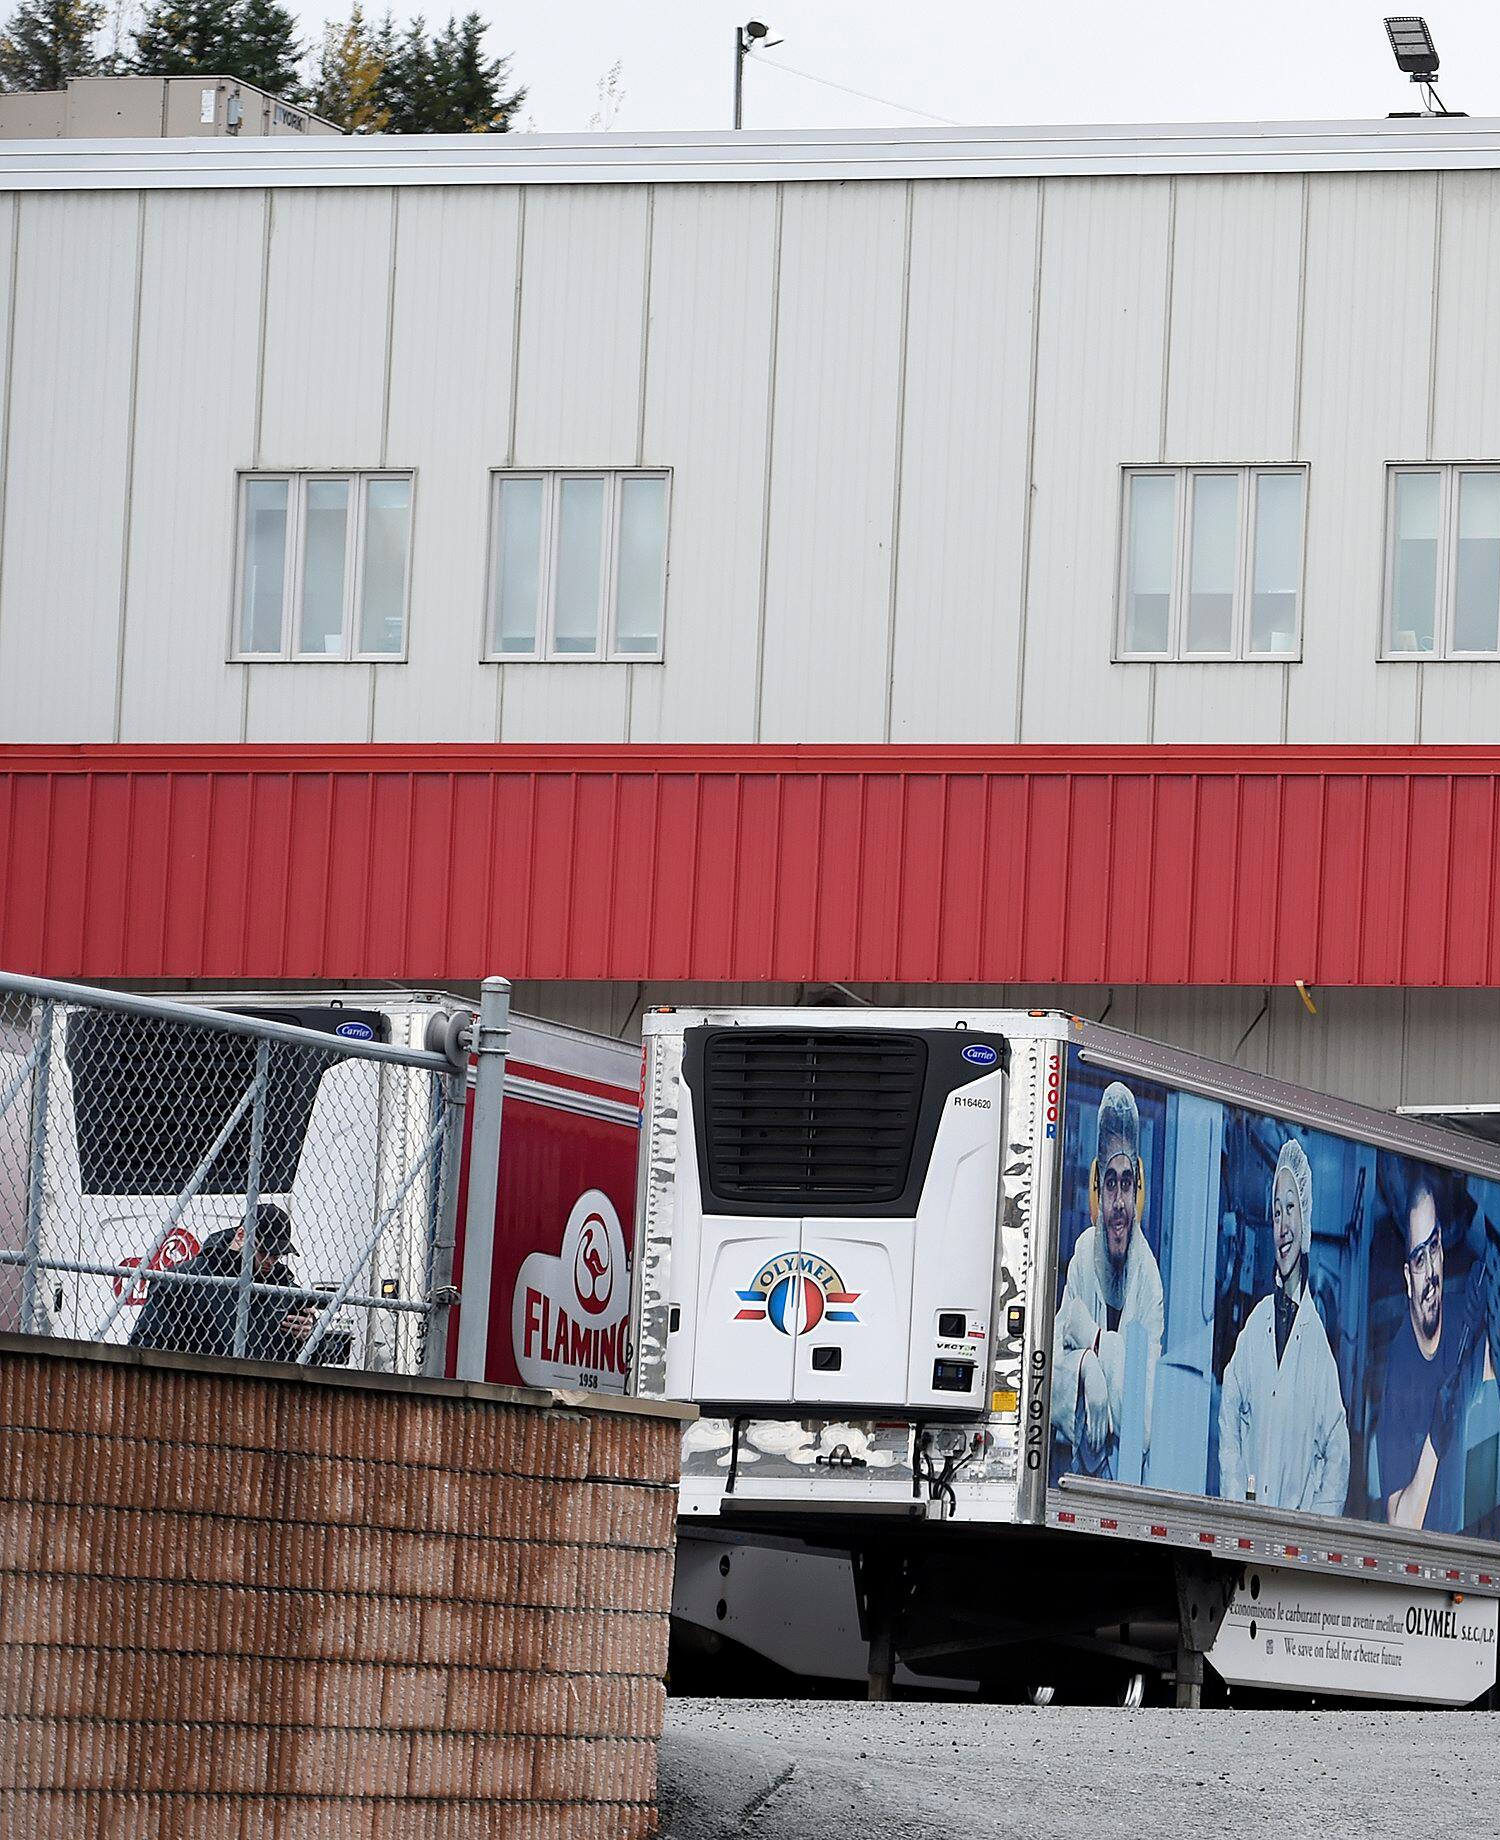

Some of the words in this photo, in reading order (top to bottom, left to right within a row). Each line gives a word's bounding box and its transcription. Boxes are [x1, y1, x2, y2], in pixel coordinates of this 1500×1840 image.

[341, 1026, 370, 1037] Carrier
[966, 1049, 994, 1060] Carrier
[954, 1097, 992, 1109] R164620
[1046, 1055, 1061, 1140] 3000R
[760, 1257, 834, 1290] OLYMEL
[936, 1343, 977, 1351] VECTOR
[578, 1373, 599, 1389] 1958
[1027, 1350, 1046, 1470] 97920
[1277, 1601, 1285, 1620] le
[1285, 1603, 1321, 1624] carburant
[1321, 1611, 1340, 1631] pour
[1341, 1614, 1352, 1627] un
[1352, 1613, 1375, 1630] avenir
[1375, 1614, 1404, 1634] meilleur
[1405, 1606, 1458, 1640] OLYMEL
[1284, 1637, 1296, 1656] We
[1297, 1643, 1313, 1657] save
[1314, 1645, 1324, 1658] on
[1325, 1640, 1340, 1660] fuel
[1341, 1641, 1352, 1660] for
[1353, 1648, 1360, 1661] a
[1359, 1643, 1380, 1664] better
[1380, 1646, 1402, 1667] future
